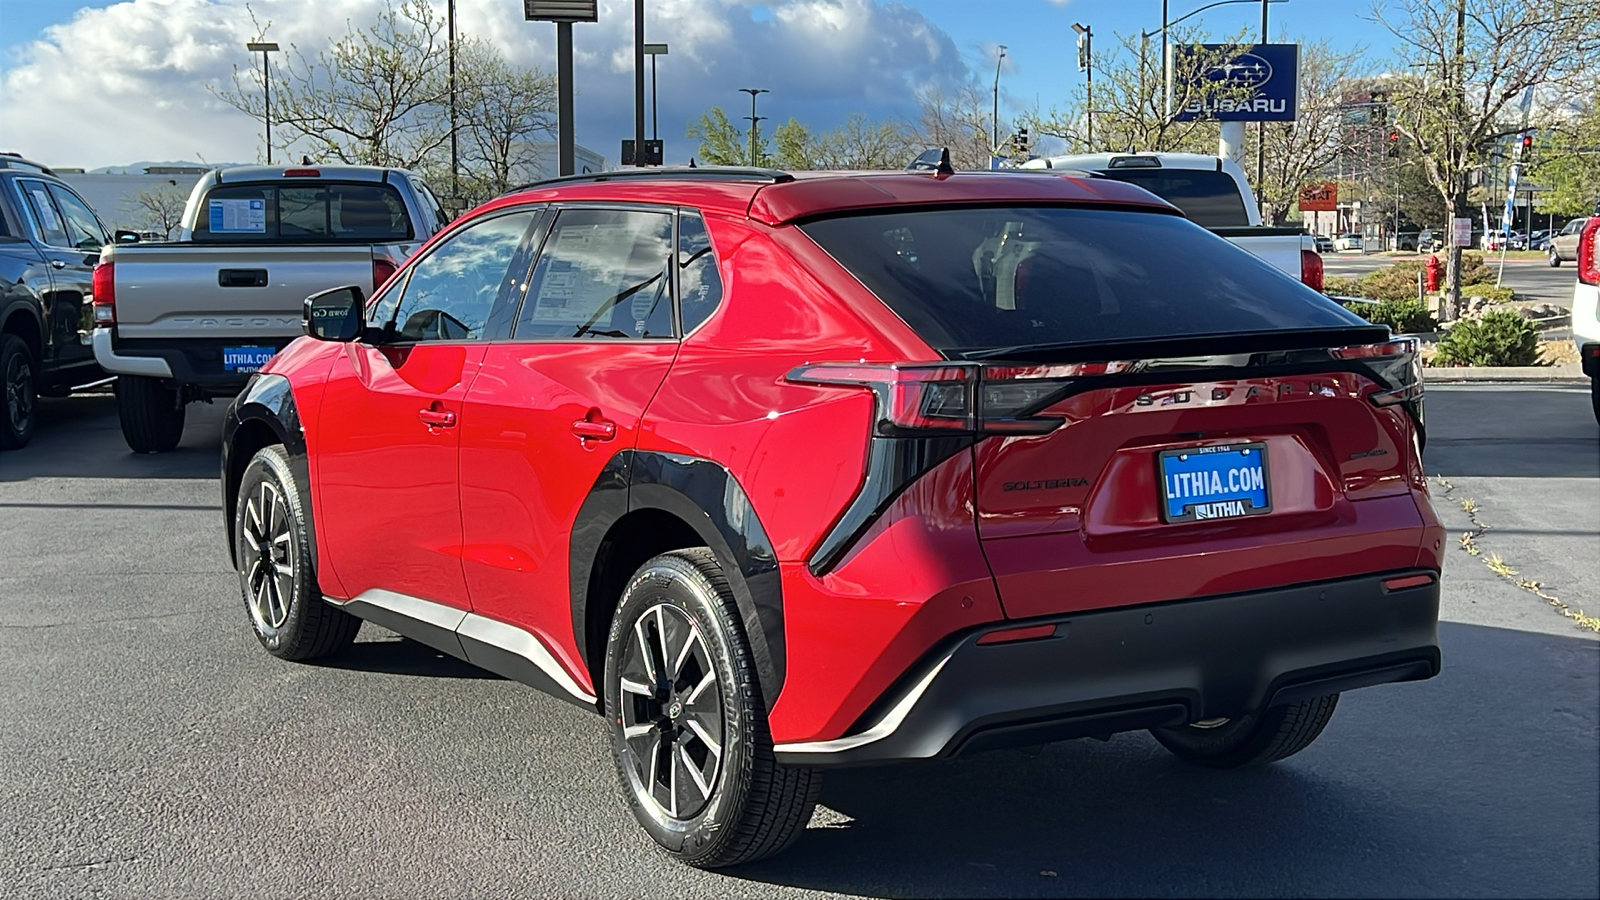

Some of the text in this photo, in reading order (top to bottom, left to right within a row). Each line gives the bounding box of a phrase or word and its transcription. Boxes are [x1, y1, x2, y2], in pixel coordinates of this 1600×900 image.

[1185, 98, 1286, 113] SUBARU
[173, 317, 298, 330] TACOM
[1136, 382, 1323, 407] SUBARU
[1199, 446, 1216, 454] SINCE
[1003, 478, 1089, 492] SOLTERRA
[1165, 466, 1264, 499] LITHIA.COM
[1206, 500, 1246, 518] LITHIA
